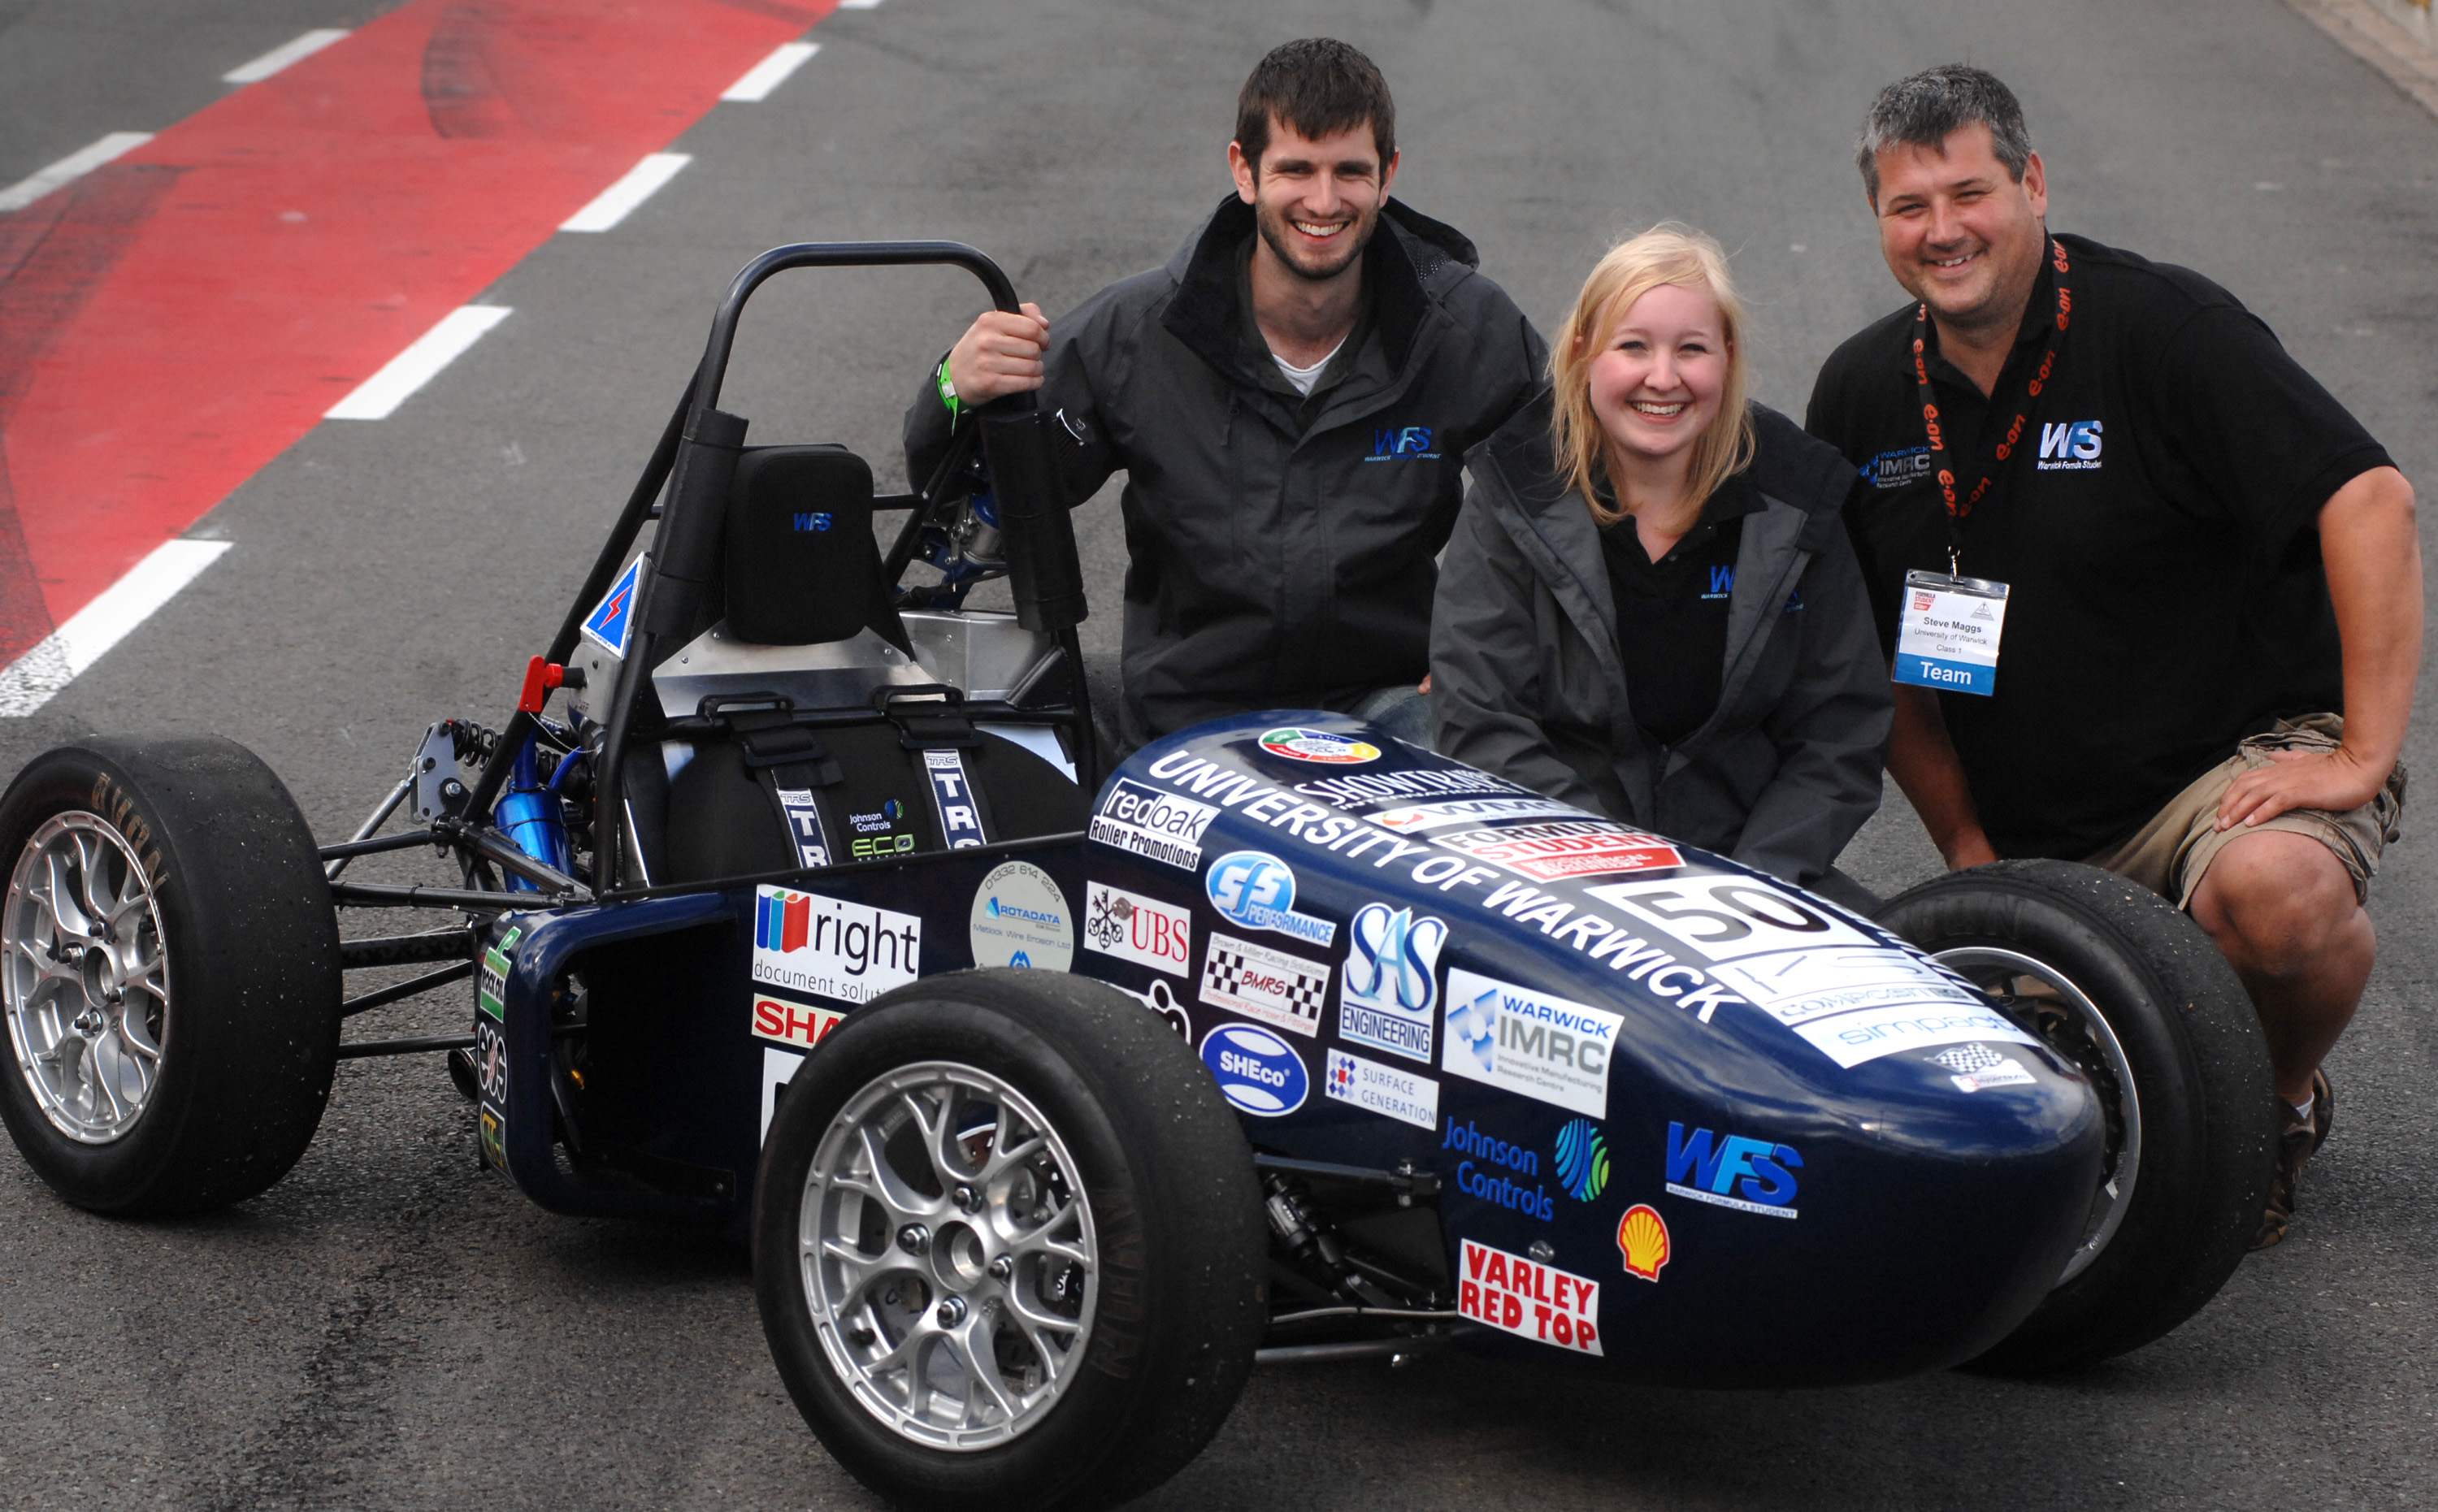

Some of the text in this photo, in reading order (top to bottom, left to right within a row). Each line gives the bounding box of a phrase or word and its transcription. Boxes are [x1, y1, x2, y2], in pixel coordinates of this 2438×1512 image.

[1374, 427, 1432, 455] WFS
[1880, 445, 1929, 458] WARWICK
[2040, 420, 2102, 459] WFS
[1880, 454, 1930, 474] IMRC
[794, 513, 832, 531] WFS
[1915, 628, 1948, 640] University
[1959, 635, 1987, 645] Warwick
[1924, 617, 1981, 634] Steve Maggs
[1937, 644, 1955, 653] Class
[1920, 661, 1972, 685] Team
[926, 756, 958, 765] TRS
[780, 793, 811, 804] TRS
[849, 812, 882, 825] Johnson
[857, 821, 891, 832] Controls
[1091, 820, 1199, 869] Roller Promotions
[1472, 834, 1672, 860] STUDENT
[985, 864, 1061, 903] 01332 614 224
[1149, 750, 1429, 869] UNIVERSITY
[1411, 856, 1495, 892] OF
[1482, 881, 1749, 1024] WARWICK
[1000, 905, 1061, 925] ROTADATA
[1247, 903, 1334, 943] PERFORMANCE
[1622, 885, 1830, 943] 50
[815, 903, 918, 976] right
[973, 924, 1071, 950] Matlock Wire Erosion Ltd
[1131, 905, 1188, 962] UBS
[1212, 936, 1325, 977] Brown & Miller Racing Solutions
[1345, 905, 1444, 1012] SAS
[754, 959, 886, 1002] document solut
[1241, 971, 1286, 995] BMRS
[1204, 989, 1244, 1008] Professional
[1244, 1002, 1261, 1013] Race
[1286, 1017, 1315, 1032] Fittings
[1503, 995, 1612, 1039] WARWICK
[1342, 1006, 1429, 1053] ENGINEERING
[1499, 1016, 1606, 1076] IMRC
[1838, 1015, 2020, 1045] simpact
[1363, 1068, 1414, 1096] SURFACE
[1497, 1065, 1564, 1093] Research Centre
[1498, 1054, 1603, 1094] Innovative Manufacturing
[1361, 1090, 1436, 1124] GENERATION
[1442, 1116, 1538, 1176] Johnson
[1666, 1120, 1804, 1207] WFS
[1457, 1160, 1554, 1222] Controls
[1668, 1185, 1795, 1218] WARWICK FORMULA STUDENT
[1467, 1243, 1594, 1315] VARLEY
[1462, 1279, 1597, 1350] RED TOP
